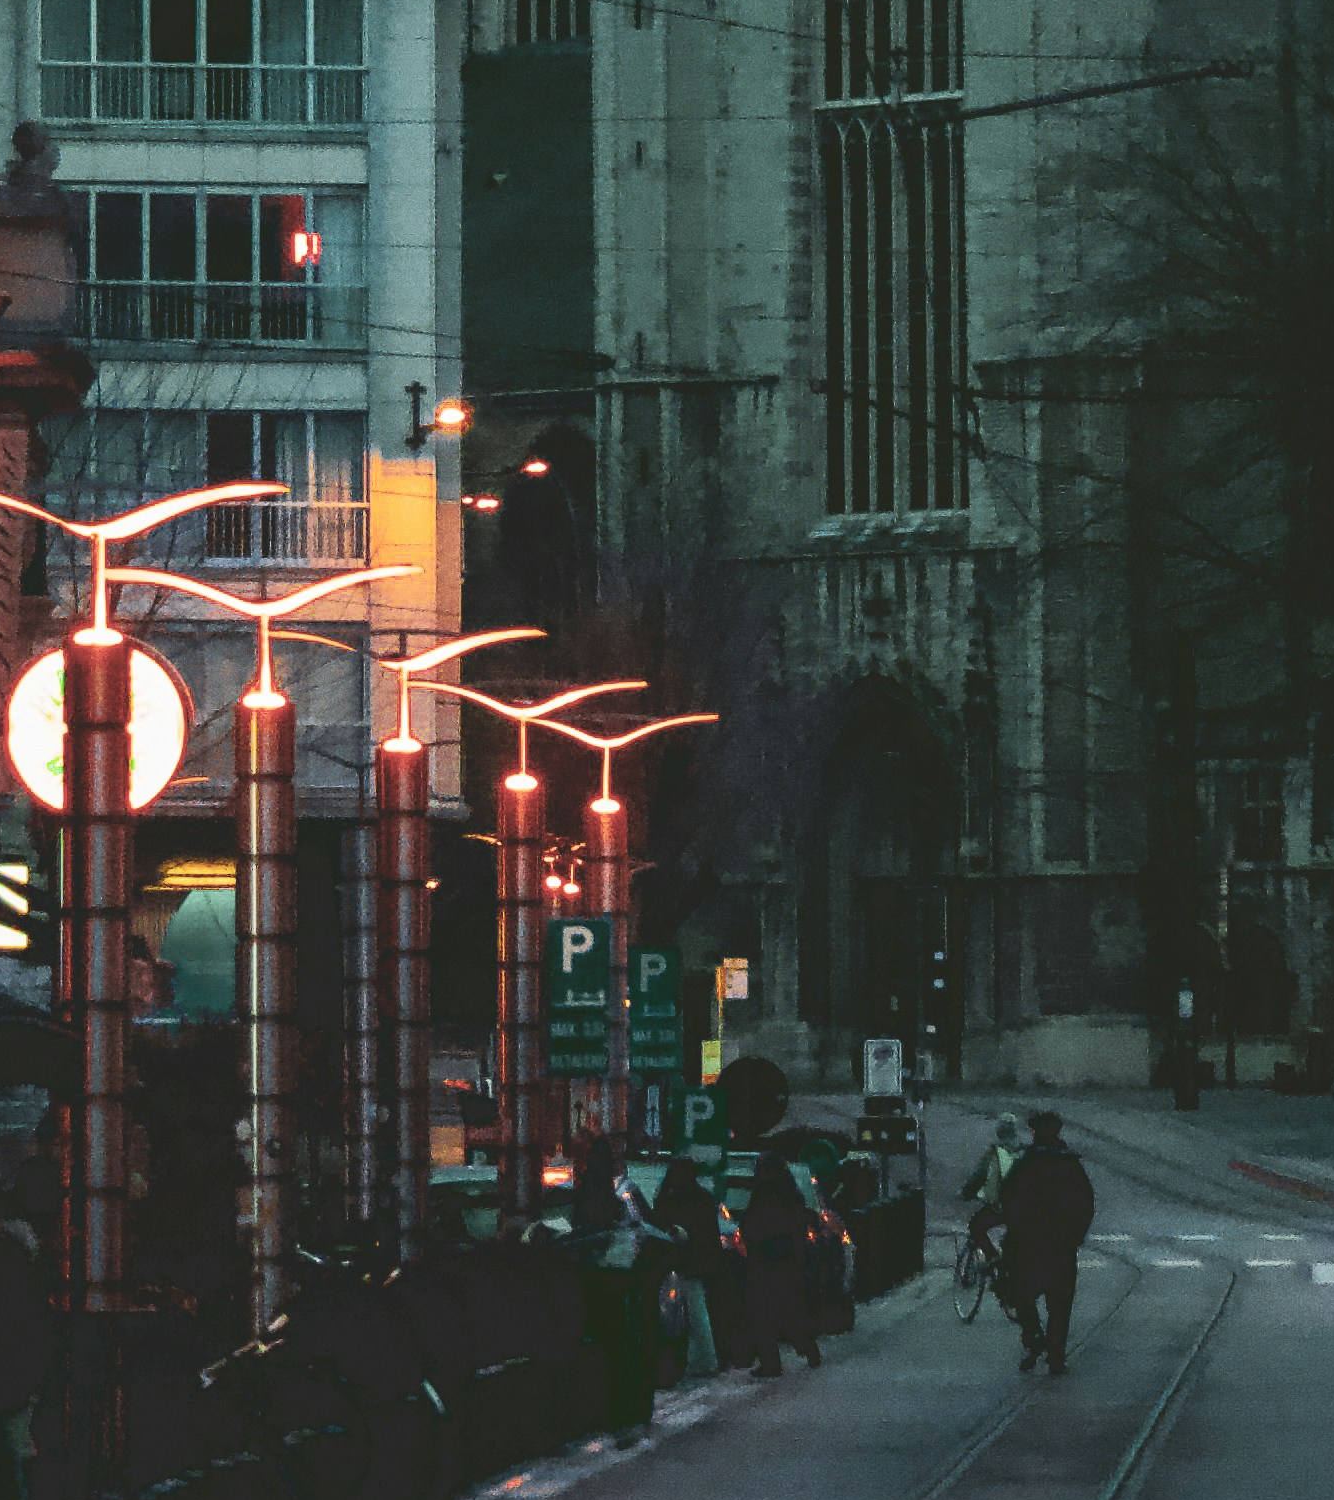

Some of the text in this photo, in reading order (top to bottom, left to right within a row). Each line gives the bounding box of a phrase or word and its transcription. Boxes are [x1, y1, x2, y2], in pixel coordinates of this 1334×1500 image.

[562, 926, 594, 973] P
[640, 953, 667, 992] P
[684, 1094, 715, 1139] P
